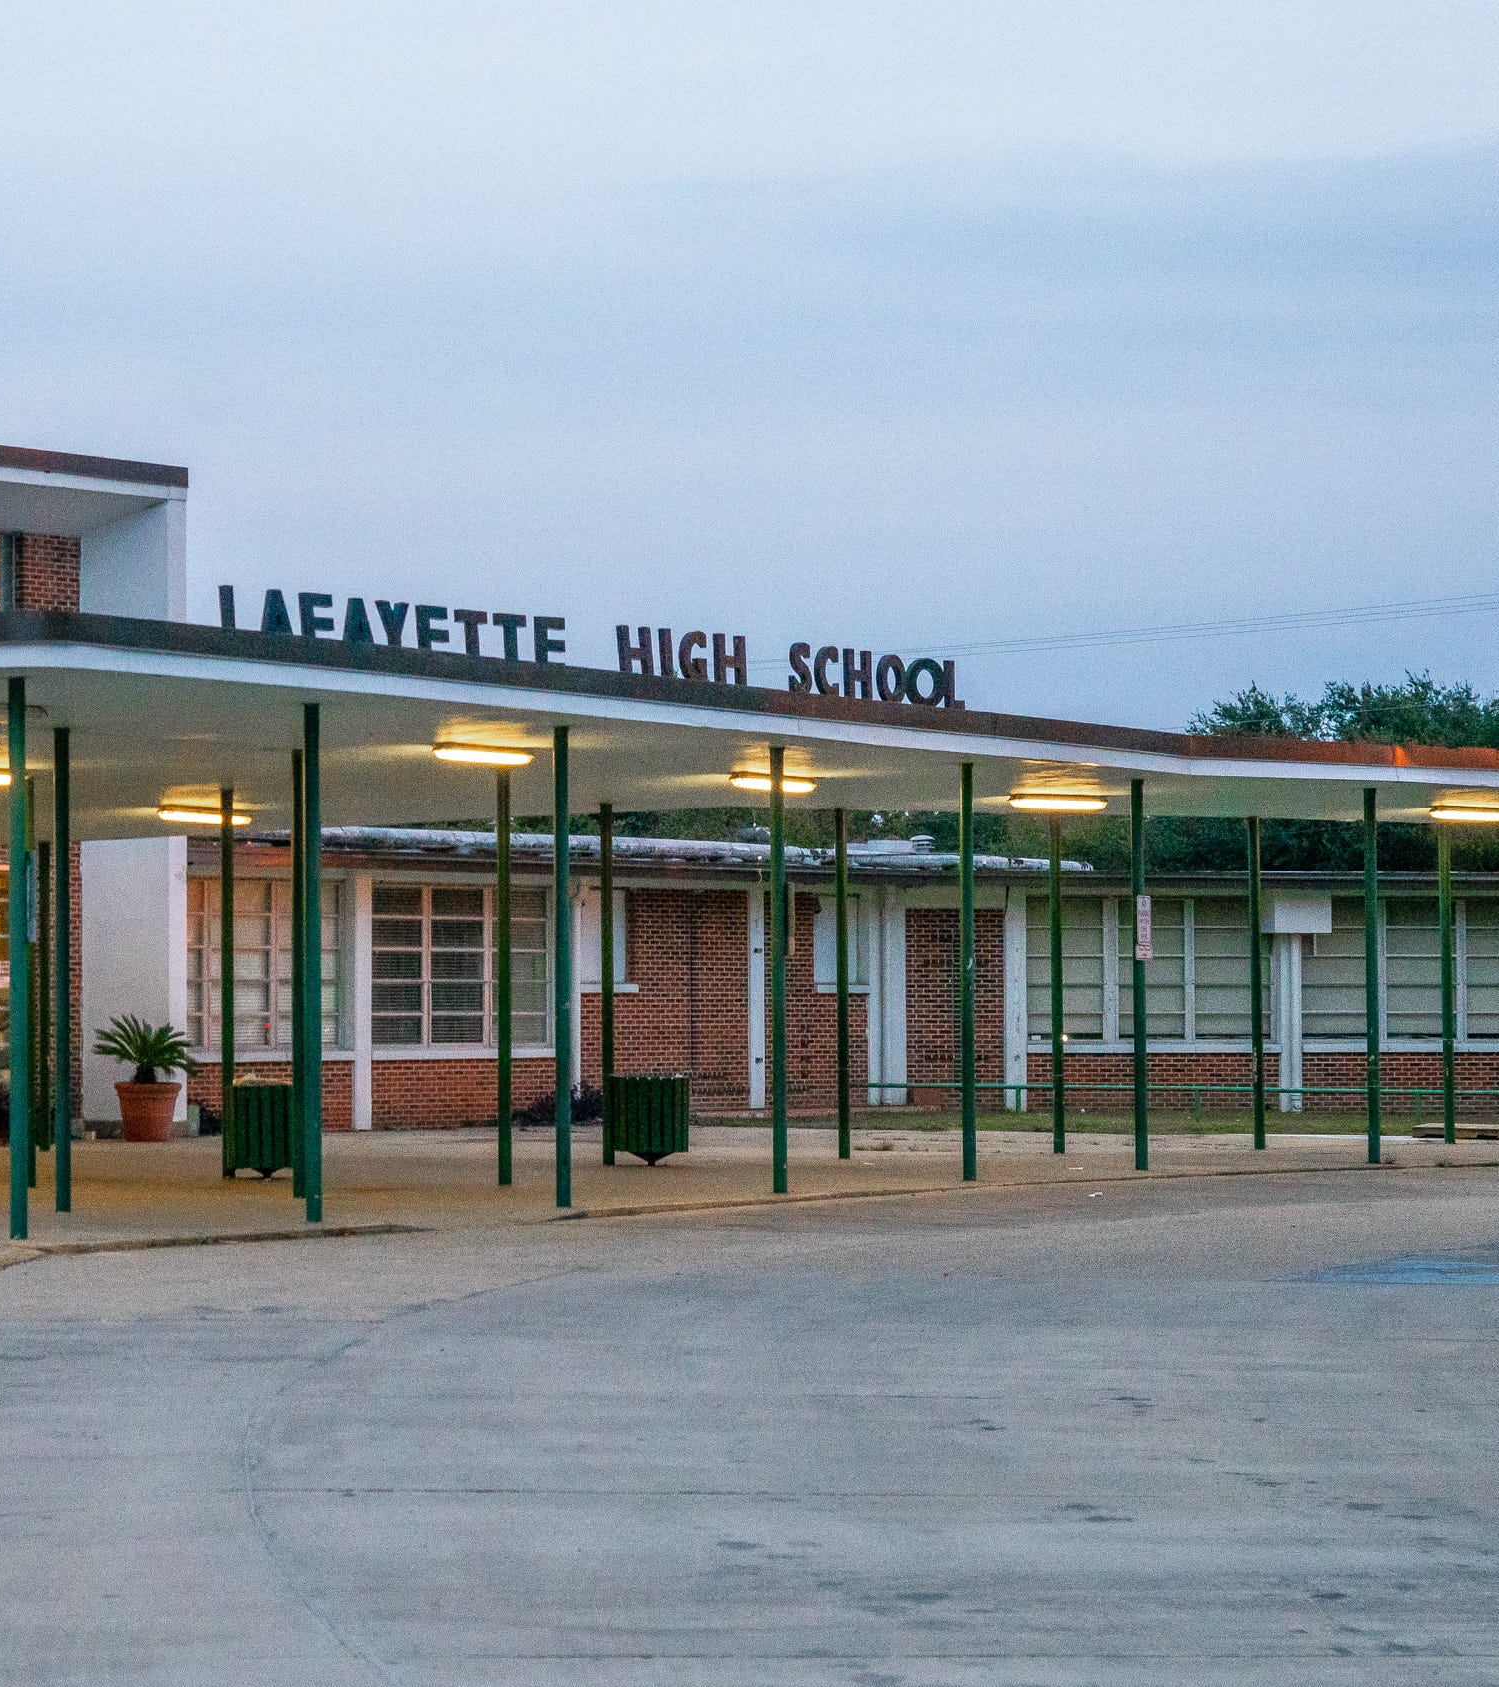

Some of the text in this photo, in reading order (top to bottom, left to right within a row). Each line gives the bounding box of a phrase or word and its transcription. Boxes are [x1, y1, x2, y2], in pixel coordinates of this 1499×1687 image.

[218, 584, 966, 710] LAFAYETTE HIGH SCHOOL
